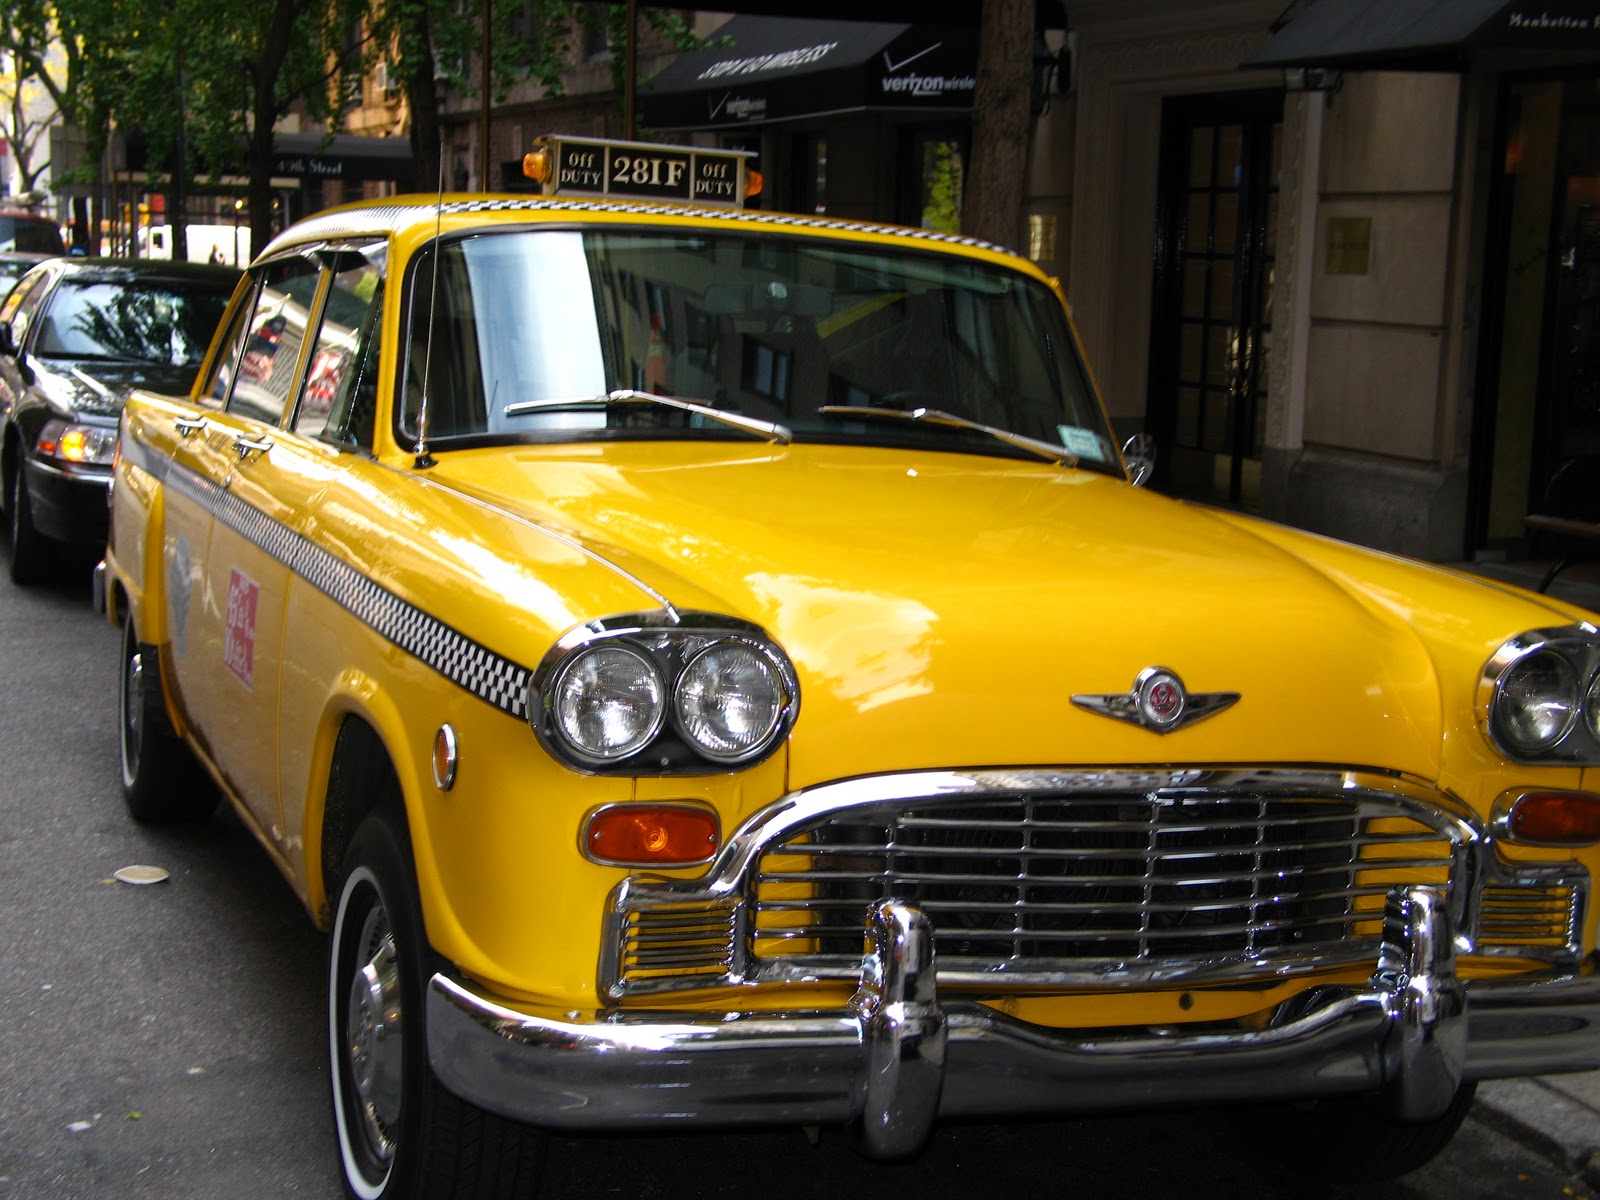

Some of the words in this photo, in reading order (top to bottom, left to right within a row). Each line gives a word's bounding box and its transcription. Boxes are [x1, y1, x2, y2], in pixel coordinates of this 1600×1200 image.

[882, 72, 944, 96] verizon
[944, 75, 976, 90] wirele
[568, 152, 595, 168] Off
[560, 168, 602, 186] DUTY
[702, 163, 728, 178] Off
[695, 179, 734, 195] DUTY
